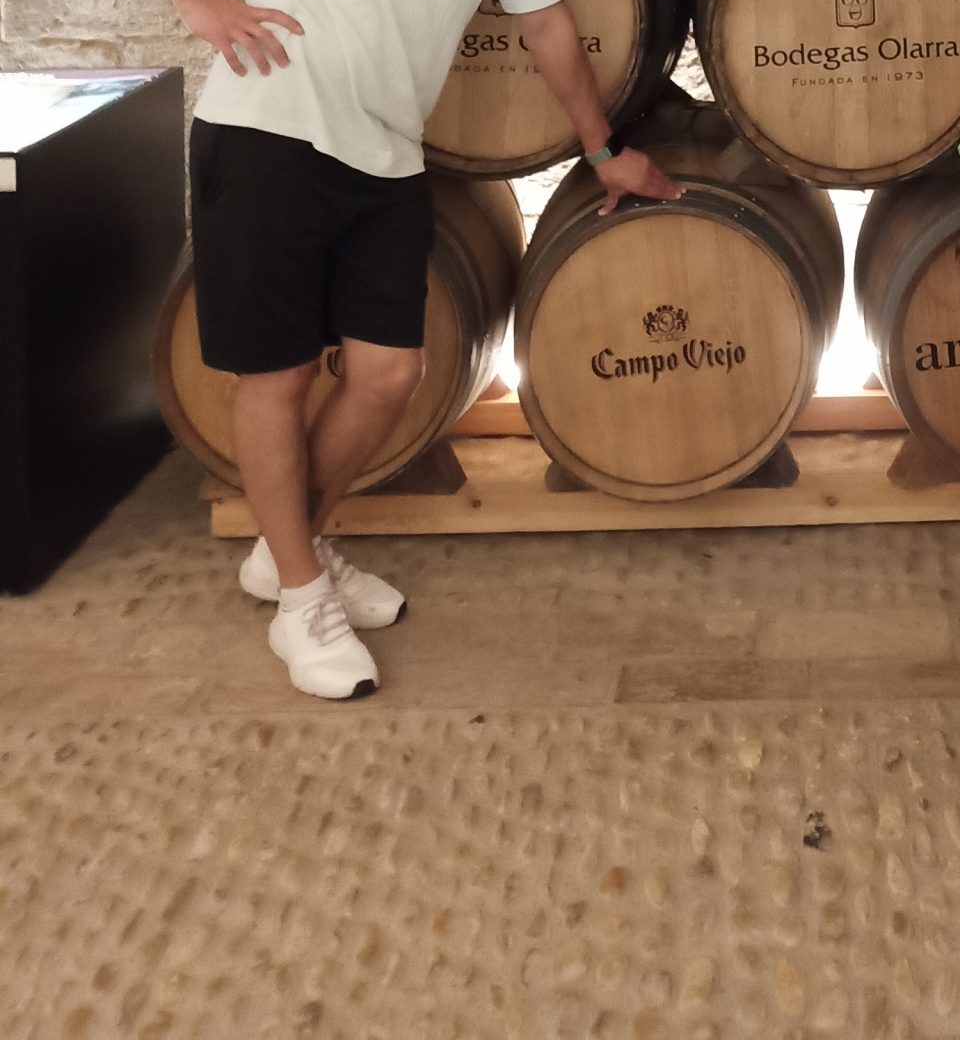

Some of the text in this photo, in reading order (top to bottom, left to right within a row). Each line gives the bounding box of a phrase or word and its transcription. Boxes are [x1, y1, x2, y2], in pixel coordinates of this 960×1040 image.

[456, 33, 510, 58] gas
[754, 37, 960, 71] Bodegas Olarra
[449, 64, 491, 73] DADA
[499, 65, 517, 73] EN
[791, 70, 925, 88] FUNDADA EN 1973
[591, 338, 747, 384] Campo Viejo
